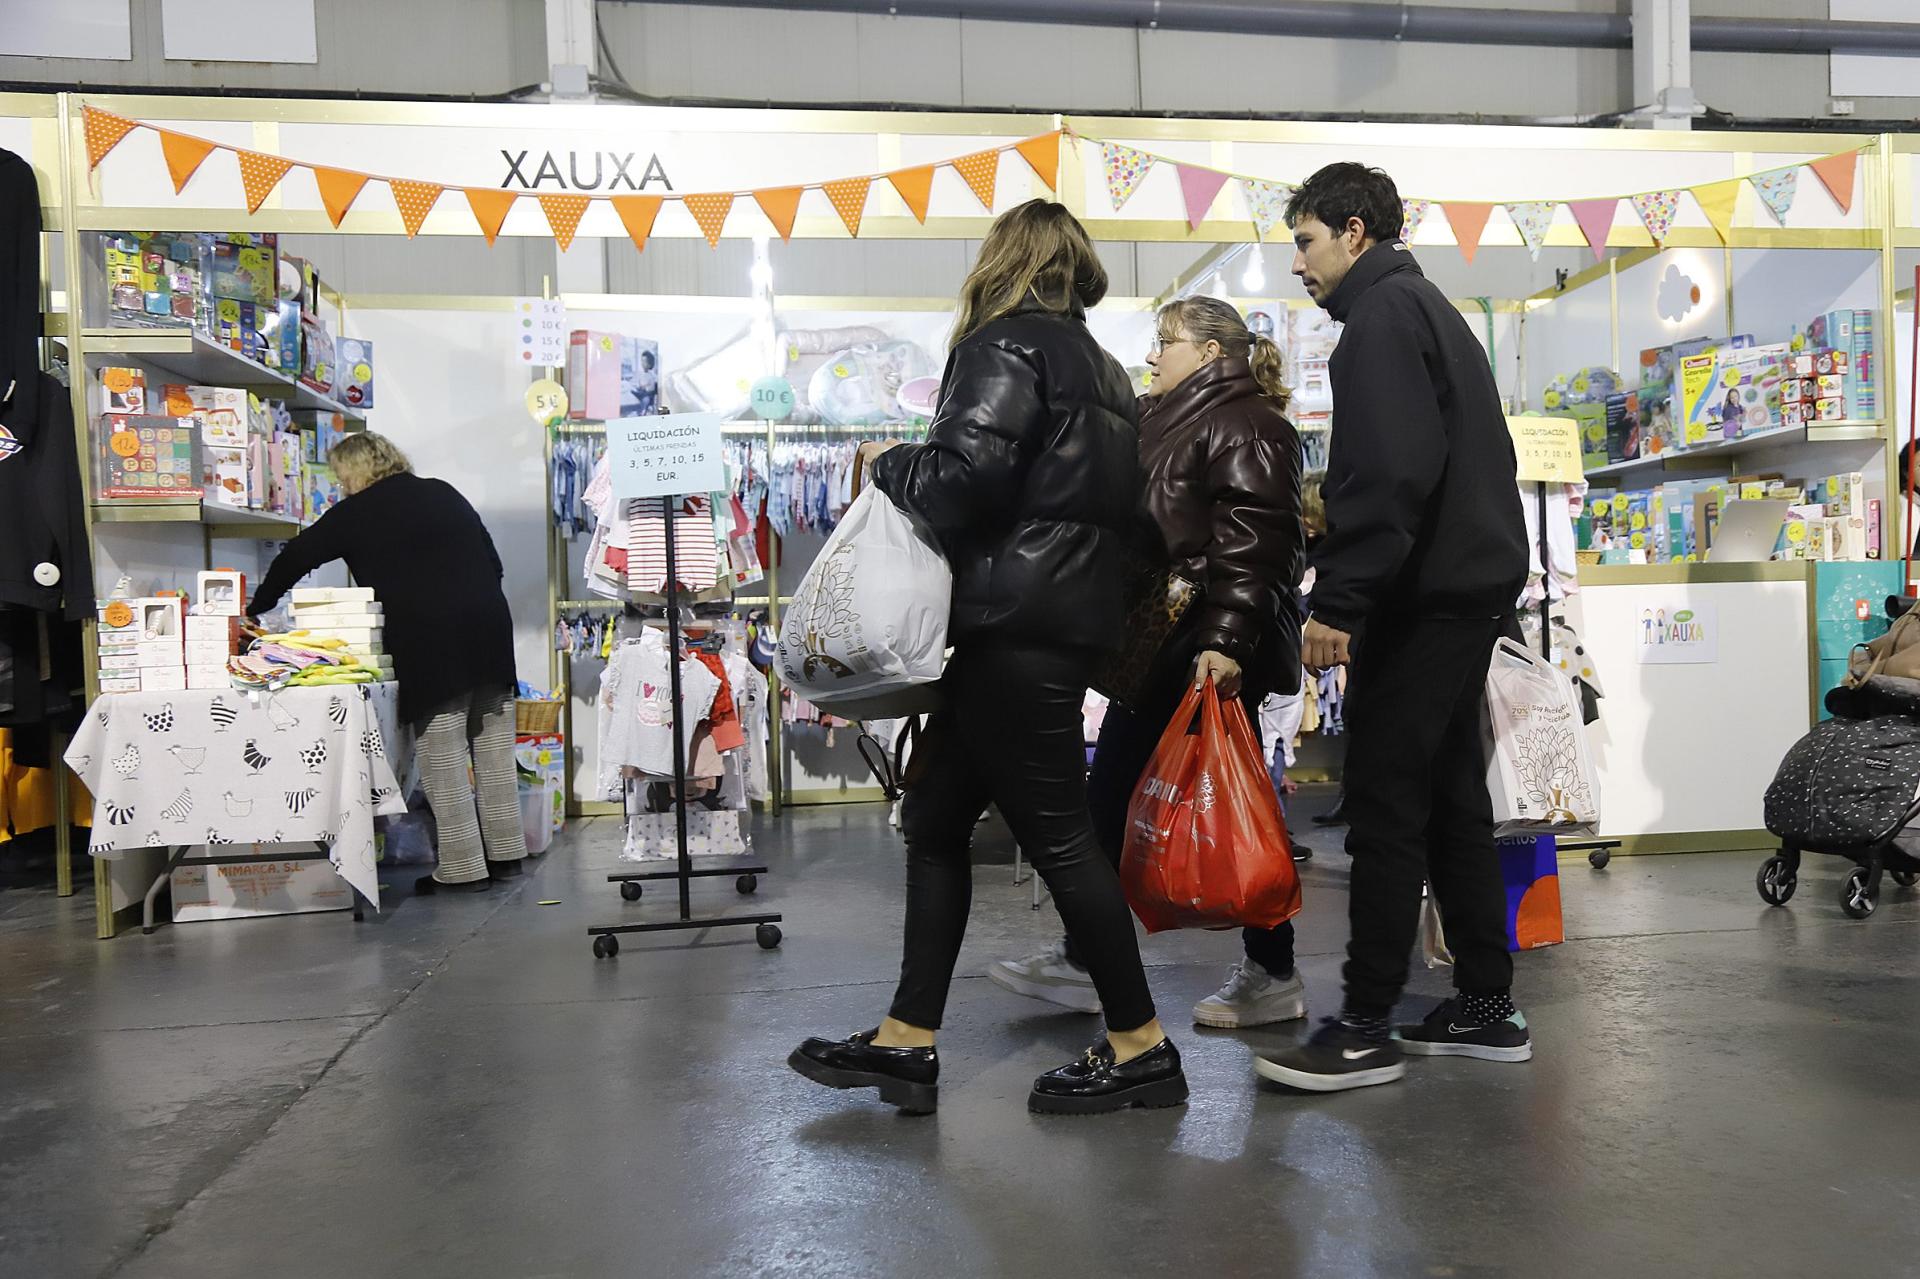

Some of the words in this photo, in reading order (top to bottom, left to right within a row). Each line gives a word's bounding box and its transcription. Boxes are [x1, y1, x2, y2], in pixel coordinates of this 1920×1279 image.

[500, 149, 674, 191] XAUXA
[543, 304, 550, 313] 5
[552, 304, 559, 314] €
[541, 320, 553, 329] 10
[541, 337, 553, 345] 15
[541, 353, 553, 361] 20
[536, 395, 545, 409] 5
[756, 389, 775, 402] 10
[780, 391, 790, 404] €
[627, 425, 700, 442] LIQUIDACIÓN
[692, 453, 705, 463] 15
[1664, 623, 1705, 641] XAUXA
